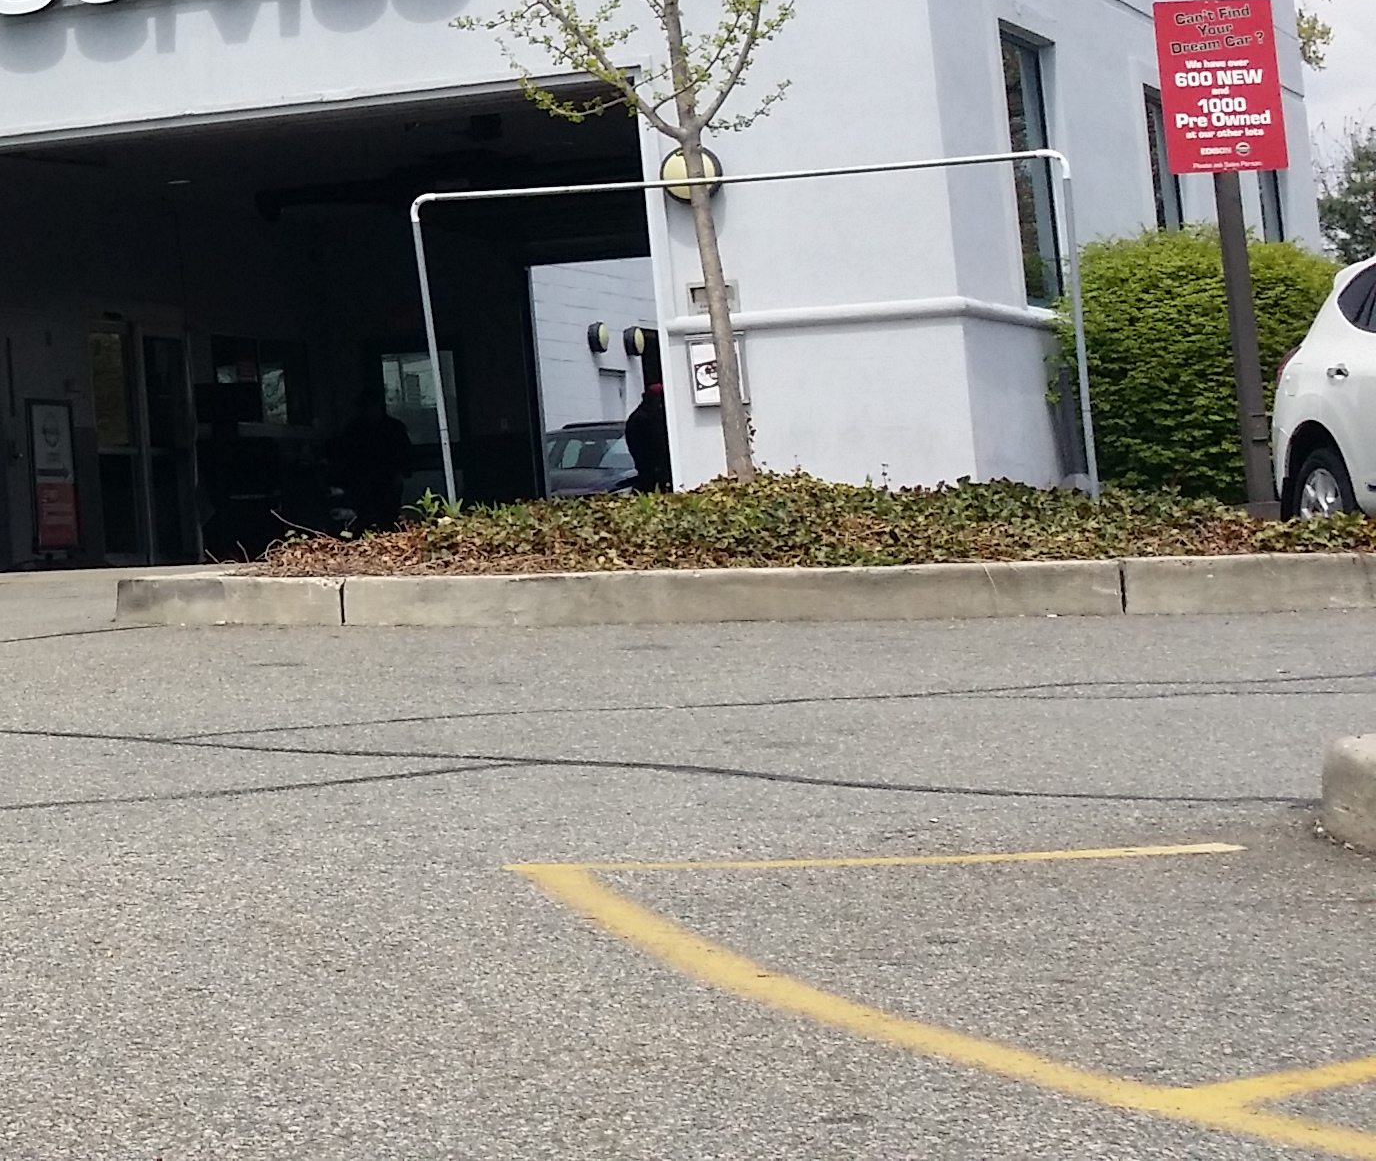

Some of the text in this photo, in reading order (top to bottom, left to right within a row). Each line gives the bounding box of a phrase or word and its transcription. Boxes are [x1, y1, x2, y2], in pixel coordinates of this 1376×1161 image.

[1174, 3, 1251, 25] Can't Find
[1197, 23, 1233, 37] Your
[1170, 39, 1222, 55] Dream
[1224, 34, 1253, 48] Car
[1184, 59, 1250, 69] We have over
[1174, 68, 1263, 88] 600 NEW
[1211, 86, 1230, 95] and
[1197, 97, 1247, 114] 1000
[1175, 109, 1272, 128] Pre Owned
[1185, 127, 1265, 139] at our other lots
